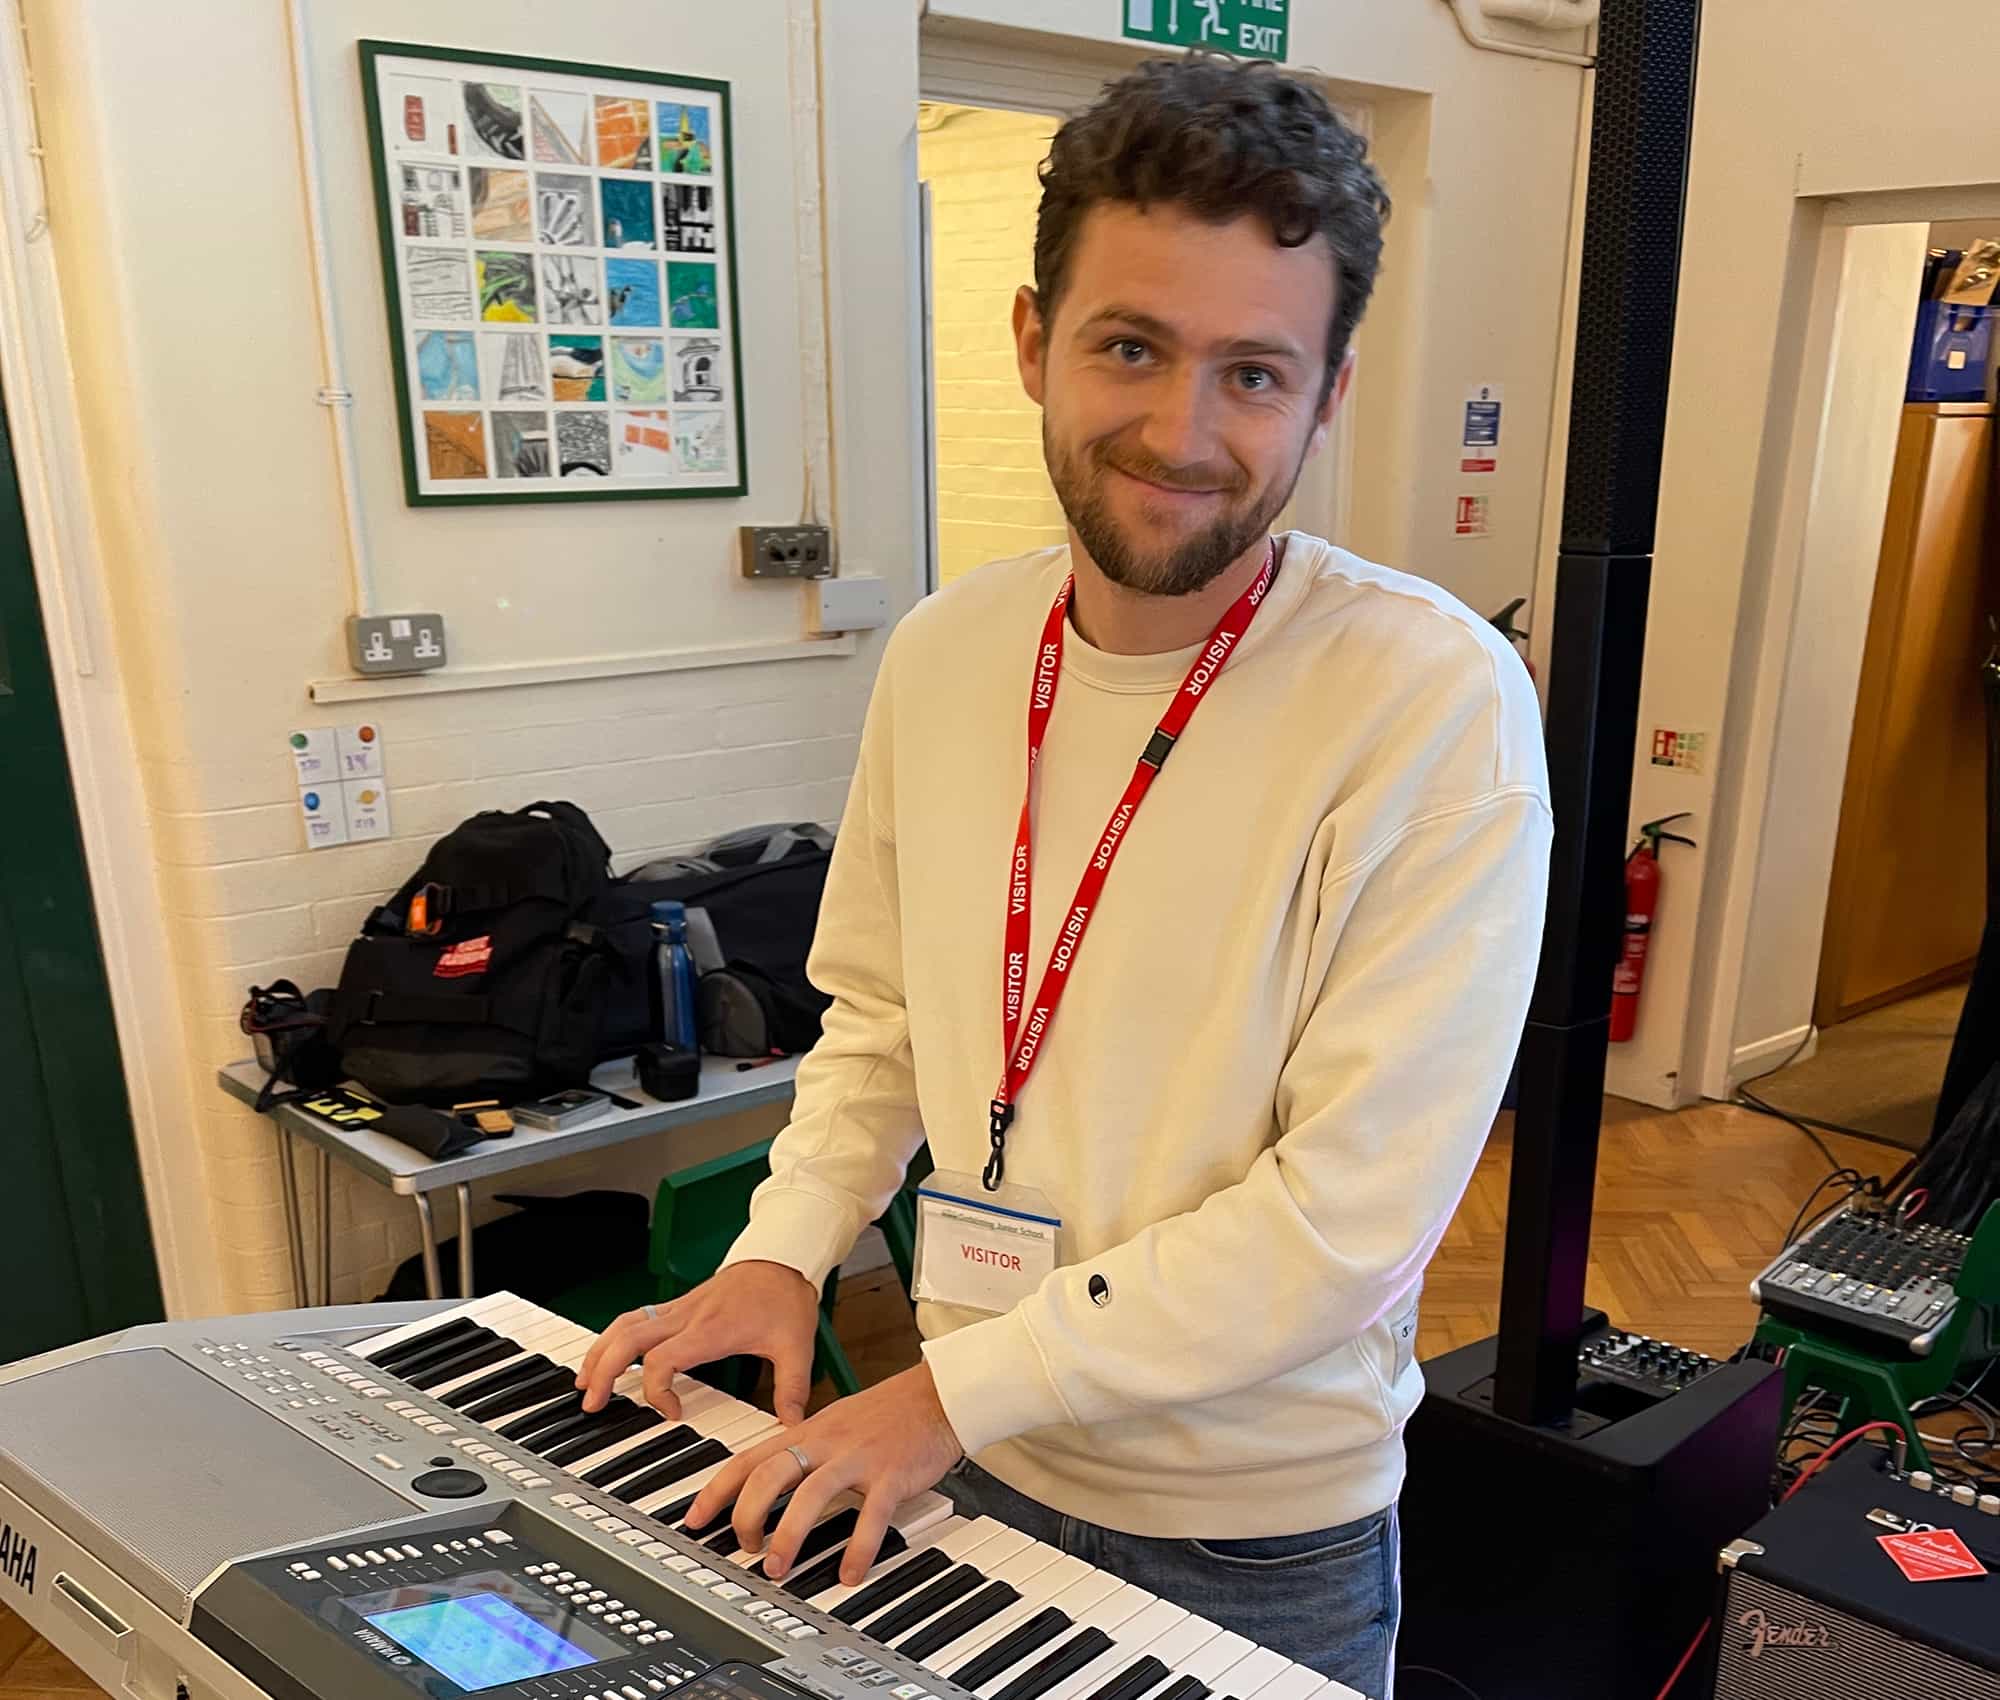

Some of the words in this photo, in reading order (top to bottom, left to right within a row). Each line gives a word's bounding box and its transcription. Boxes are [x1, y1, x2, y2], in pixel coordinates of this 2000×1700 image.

[1239, 23, 1283, 54] EXIT
[1033, 643, 1058, 710] VISITOR
[1186, 631, 1236, 696] VISITOR
[1093, 803, 1133, 870] VISITOR
[1011, 844, 1027, 915] VISITOR
[1051, 905, 1089, 972] VISITOR
[1006, 951, 1024, 1022] VISITOR
[1015, 1006, 1049, 1072] VISITOR
[960, 1244, 1021, 1272] VISITOR
[0, 1524, 37, 1595] AHA
[352, 1628, 401, 1658] YAMAHA
[1739, 1609, 1832, 1657] Fender
